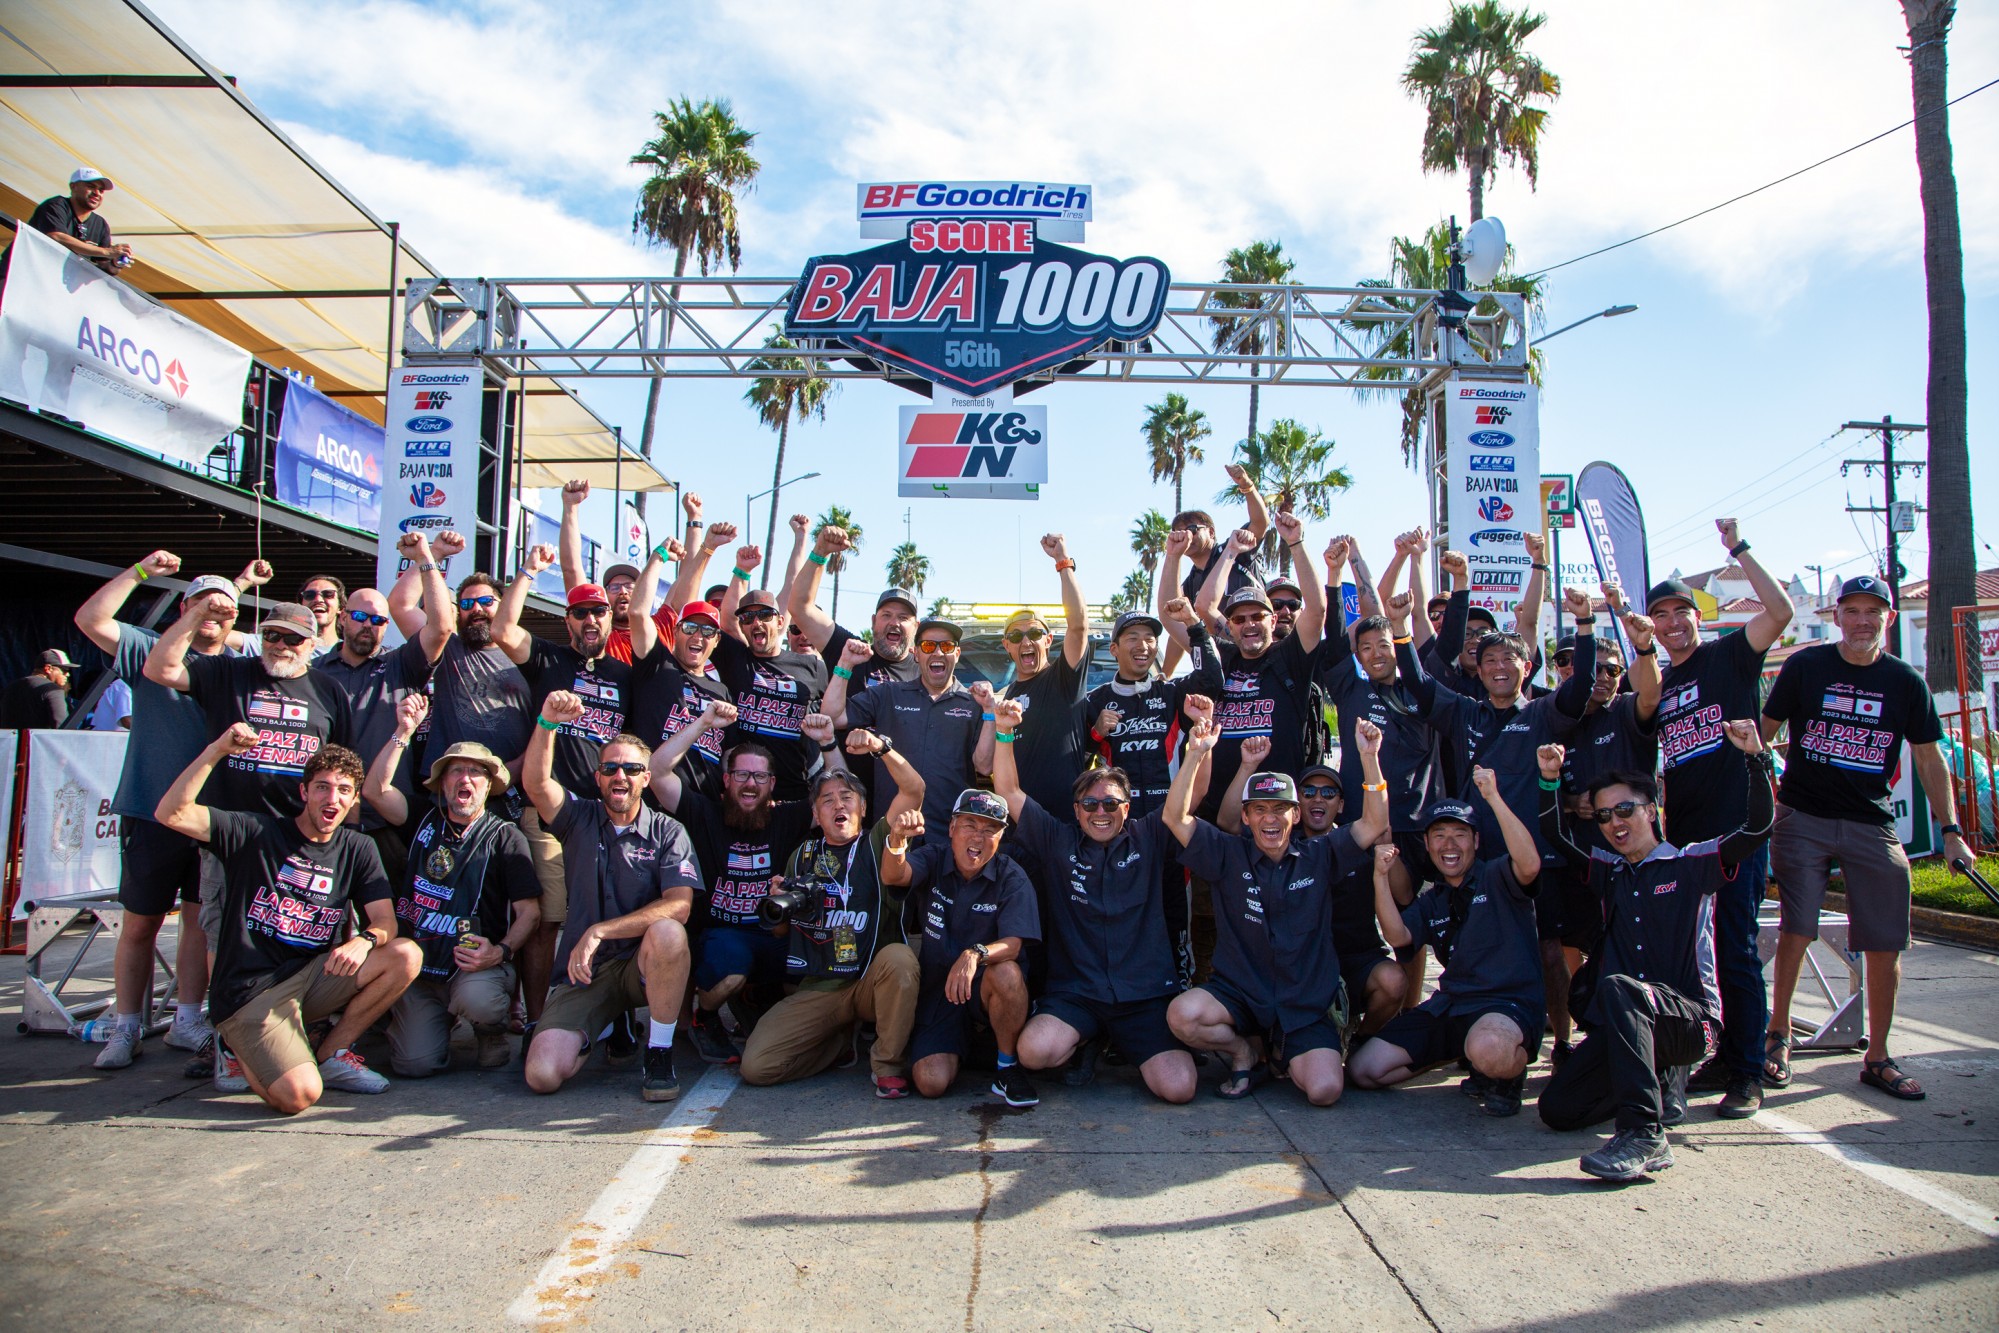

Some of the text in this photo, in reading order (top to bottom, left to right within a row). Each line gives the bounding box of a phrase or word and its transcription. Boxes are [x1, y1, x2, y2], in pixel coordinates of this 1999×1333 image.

[863, 183, 1088, 210] BFGoodrich
[1061, 210, 1084, 218] Tires
[910, 220, 1034, 254] SCORE
[794, 261, 1161, 328] BAJA 1000
[77, 316, 161, 386] ARCO
[944, 340, 1000, 368] 56th
[402, 374, 470, 383] BFGoodrich
[108, 380, 139, 401] calidad
[140, 393, 158, 406] TOP
[1460, 388, 1526, 399] BFGoodrich
[952, 398, 995, 408] Presented By
[415, 419, 443, 430] Ford
[1478, 432, 1506, 445] Ford
[316, 433, 363, 478] ARCO
[400, 463, 426, 478] BAJA
[1466, 476, 1492, 492] BAJA
[412, 482, 435, 508] VP
[1479, 496, 1503, 522] VP
[1550, 516, 1562, 526] 24
[1468, 555, 1531, 564] POLARIS
[1554, 563, 1598, 574] ORON
[1474, 572, 1519, 585] OPTIMA
[590, 696, 606, 704] BAJA
[738, 692, 756, 709] LA
[757, 697, 791, 716] PAZ
[1223, 702, 1254, 716] PAZ
[1254, 699, 1275, 714] TO
[584, 706, 614, 724] PAZ
[669, 704, 690, 722] LA
[1212, 714, 1273, 729] SENADA
[1842, 714, 1859, 722] BAJA
[556, 726, 585, 738] 8188
[1665, 714, 1695, 743] PAZ
[1695, 704, 1722, 726] TO
[258, 729, 320, 752] PAZ TO
[1664, 722, 1723, 759] SENADA
[1806, 719, 1894, 748] LA PAZ TO
[1120, 739, 1158, 752] KYB
[1800, 734, 1886, 764] ENSENADA
[228, 760, 255, 772] 8188
[714, 876, 735, 896] LA
[737, 880, 768, 898] PAZ
[254, 886, 343, 924] LA PAZ TO
[312, 892, 328, 901] 1000
[711, 893, 762, 913] ENSEN
[1247, 898, 1261, 907] TOYO
[396, 897, 423, 925] BAA
[710, 908, 739, 924] 8188
[1248, 904, 1264, 913] TIRES
[247, 902, 334, 940] ENSENADA
